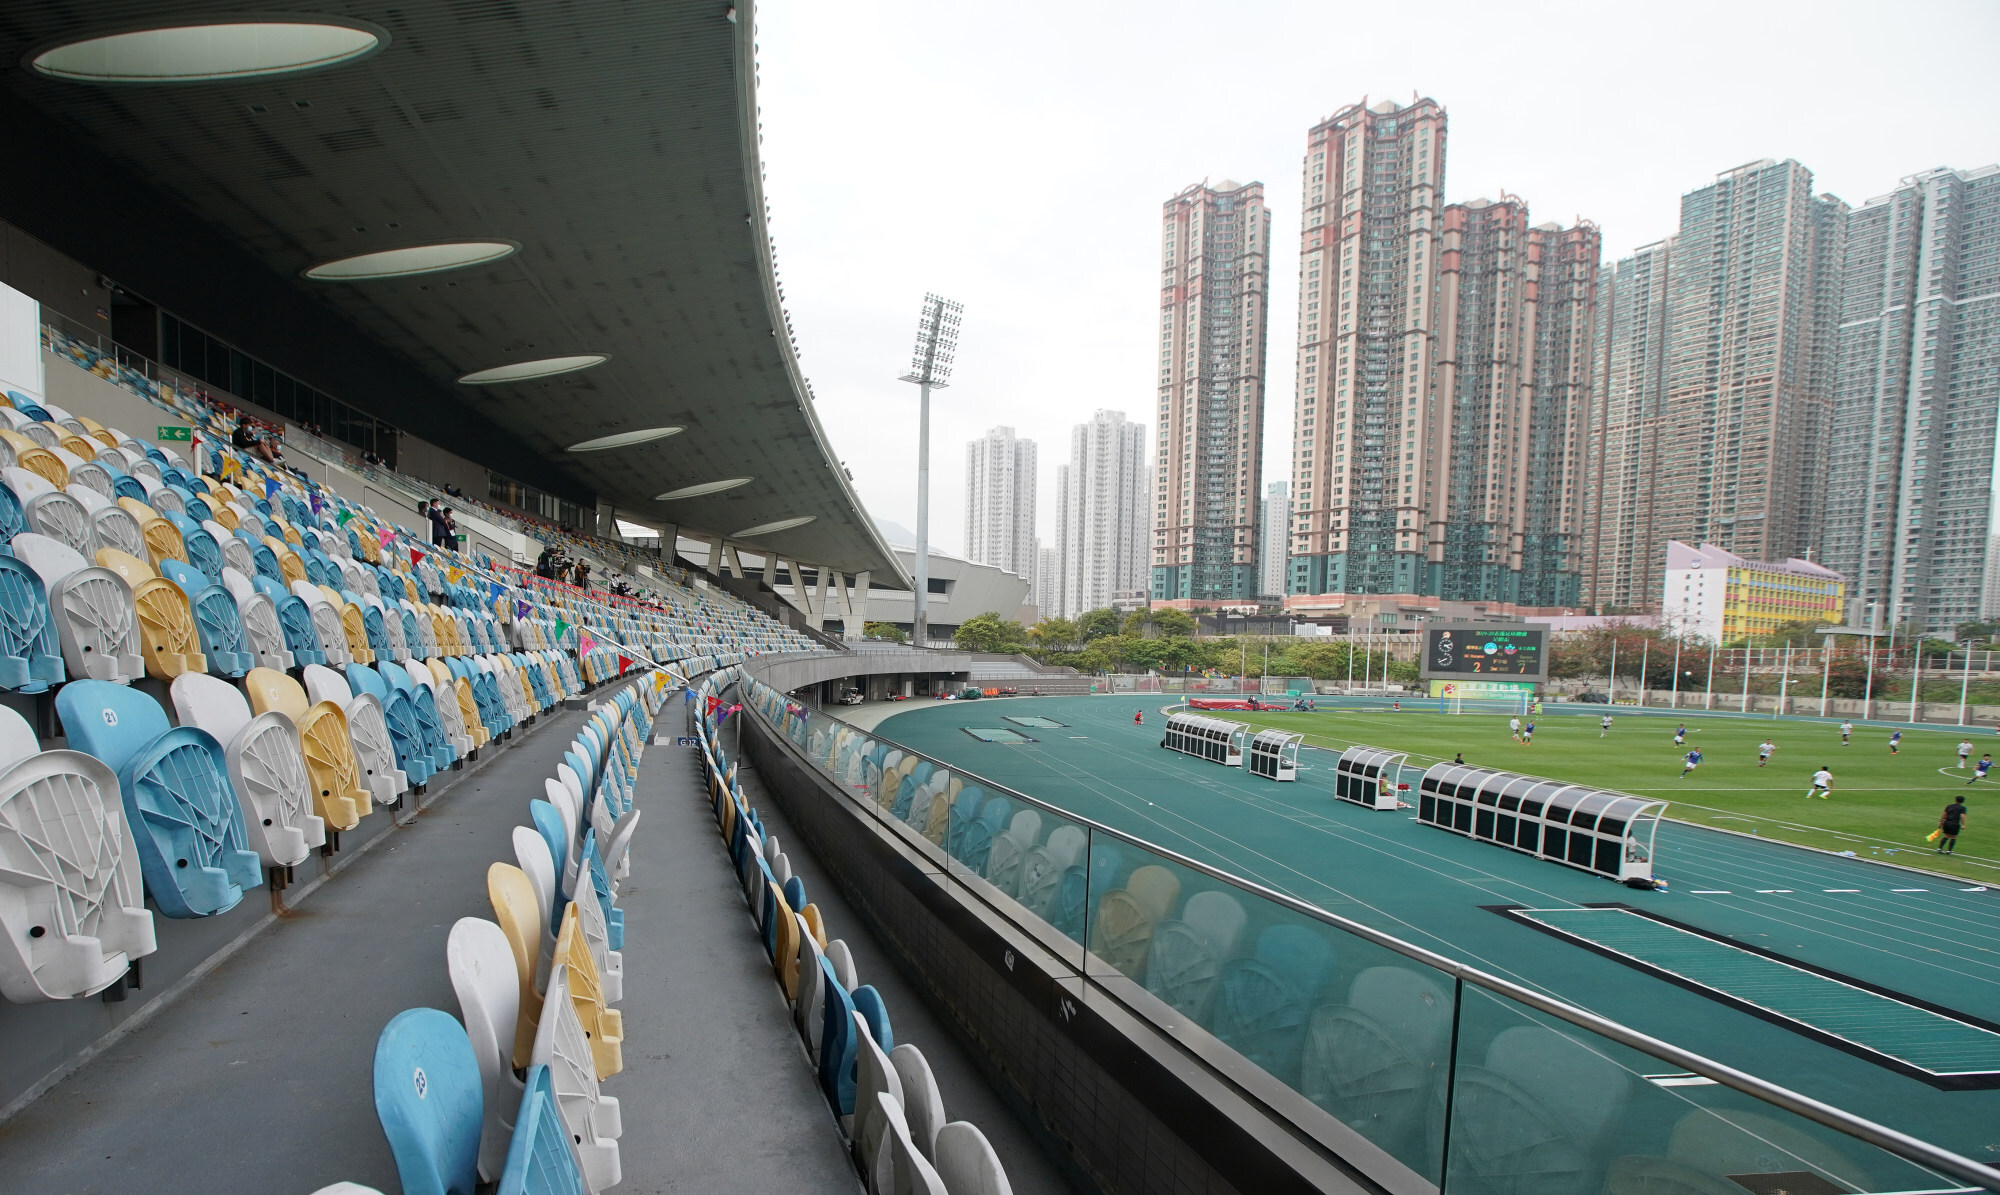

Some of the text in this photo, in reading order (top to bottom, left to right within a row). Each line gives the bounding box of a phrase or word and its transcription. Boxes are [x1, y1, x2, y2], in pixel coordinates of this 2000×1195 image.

[1473, 661, 1481, 672] 2
[1518, 663, 1526, 674] 7
[104, 711, 117, 723] 21
[415, 1071, 425, 1096] 23
